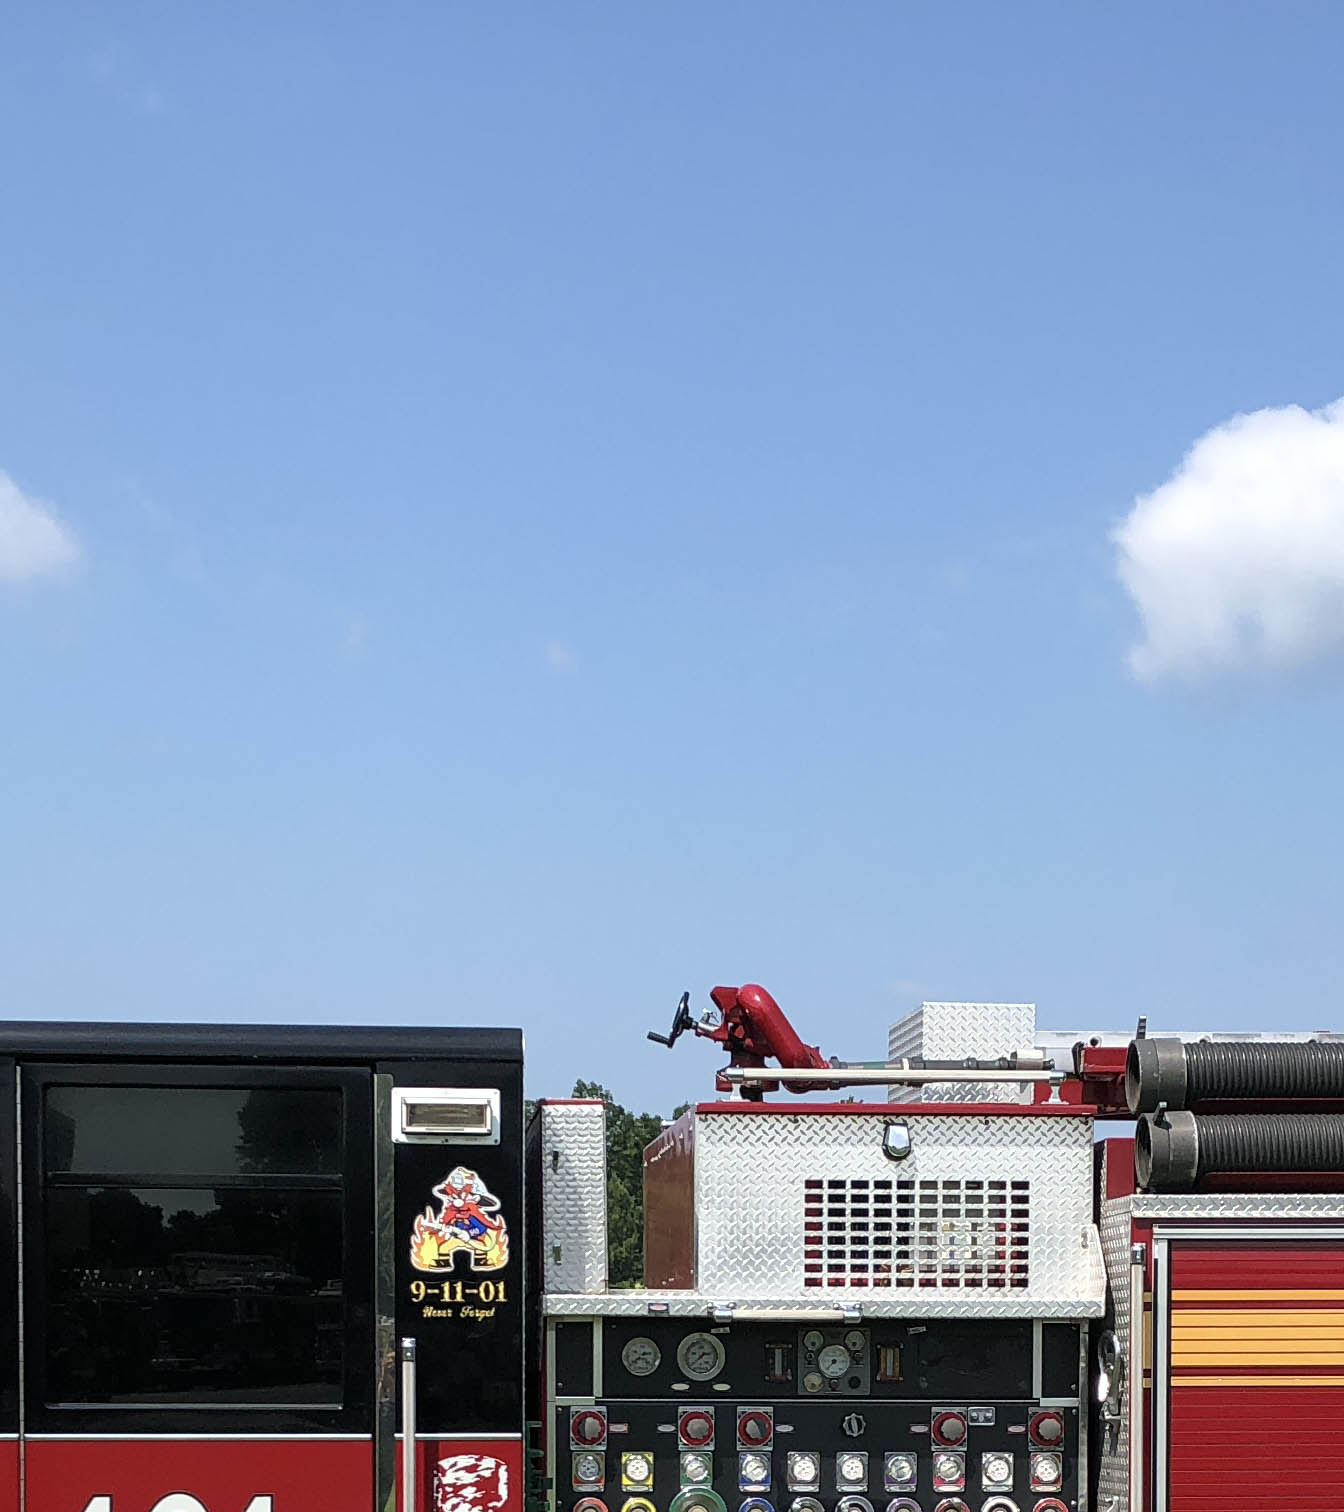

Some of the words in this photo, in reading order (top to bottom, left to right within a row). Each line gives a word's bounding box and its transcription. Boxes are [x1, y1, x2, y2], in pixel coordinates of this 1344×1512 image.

[410, 1280, 508, 1302] 9-11-01
[423, 1305, 453, 1318] Never
[459, 1304, 496, 1322] Forget
